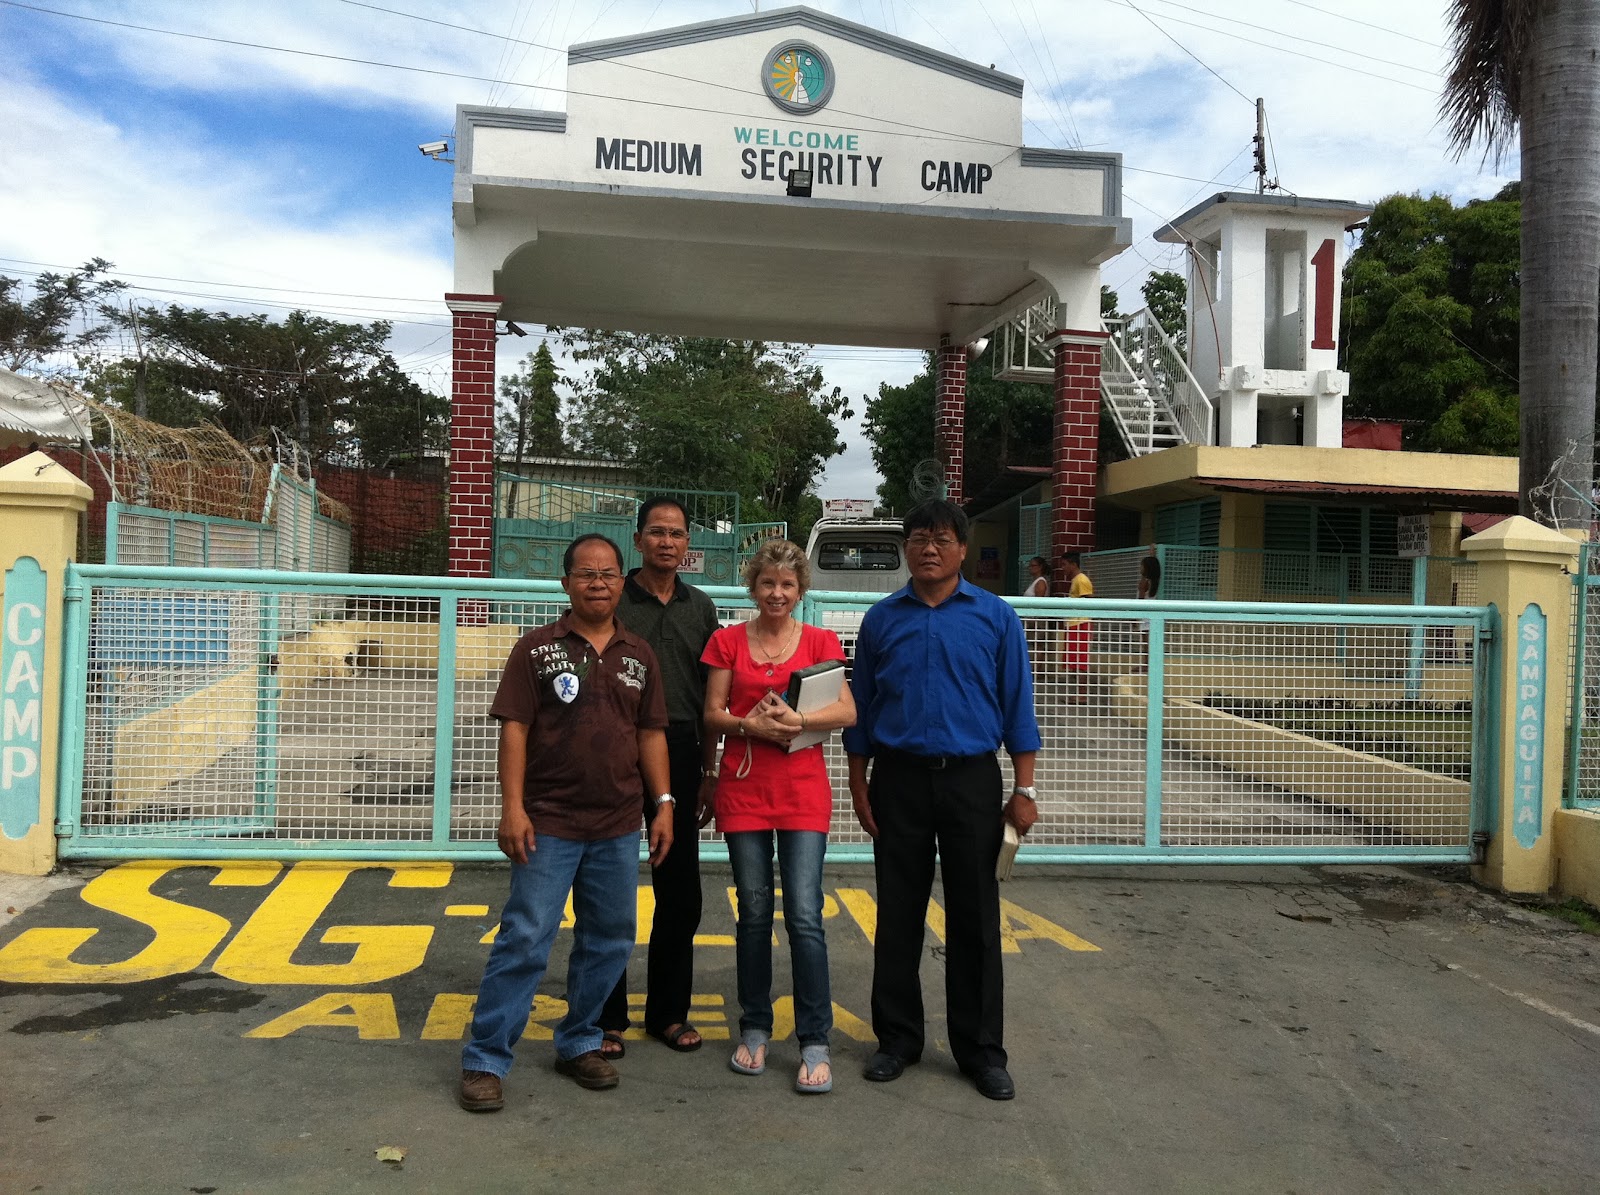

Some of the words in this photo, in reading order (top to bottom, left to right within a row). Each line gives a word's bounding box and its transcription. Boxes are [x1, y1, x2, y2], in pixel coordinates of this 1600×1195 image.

[734, 126, 859, 151] WELCOME
[595, 137, 702, 176] MEDIUM
[741, 148, 883, 187] SECURITY
[921, 160, 993, 194] CAMP
[1311, 239, 1336, 350] 1
[680, 558, 697, 566] OP
[530, 643, 562, 658] STYLE
[544, 651, 568, 662] AND
[537, 661, 576, 679] ALITY
[2, 602, 42, 790] CAMP
[1517, 623, 1541, 825] SAMPAGUITA
